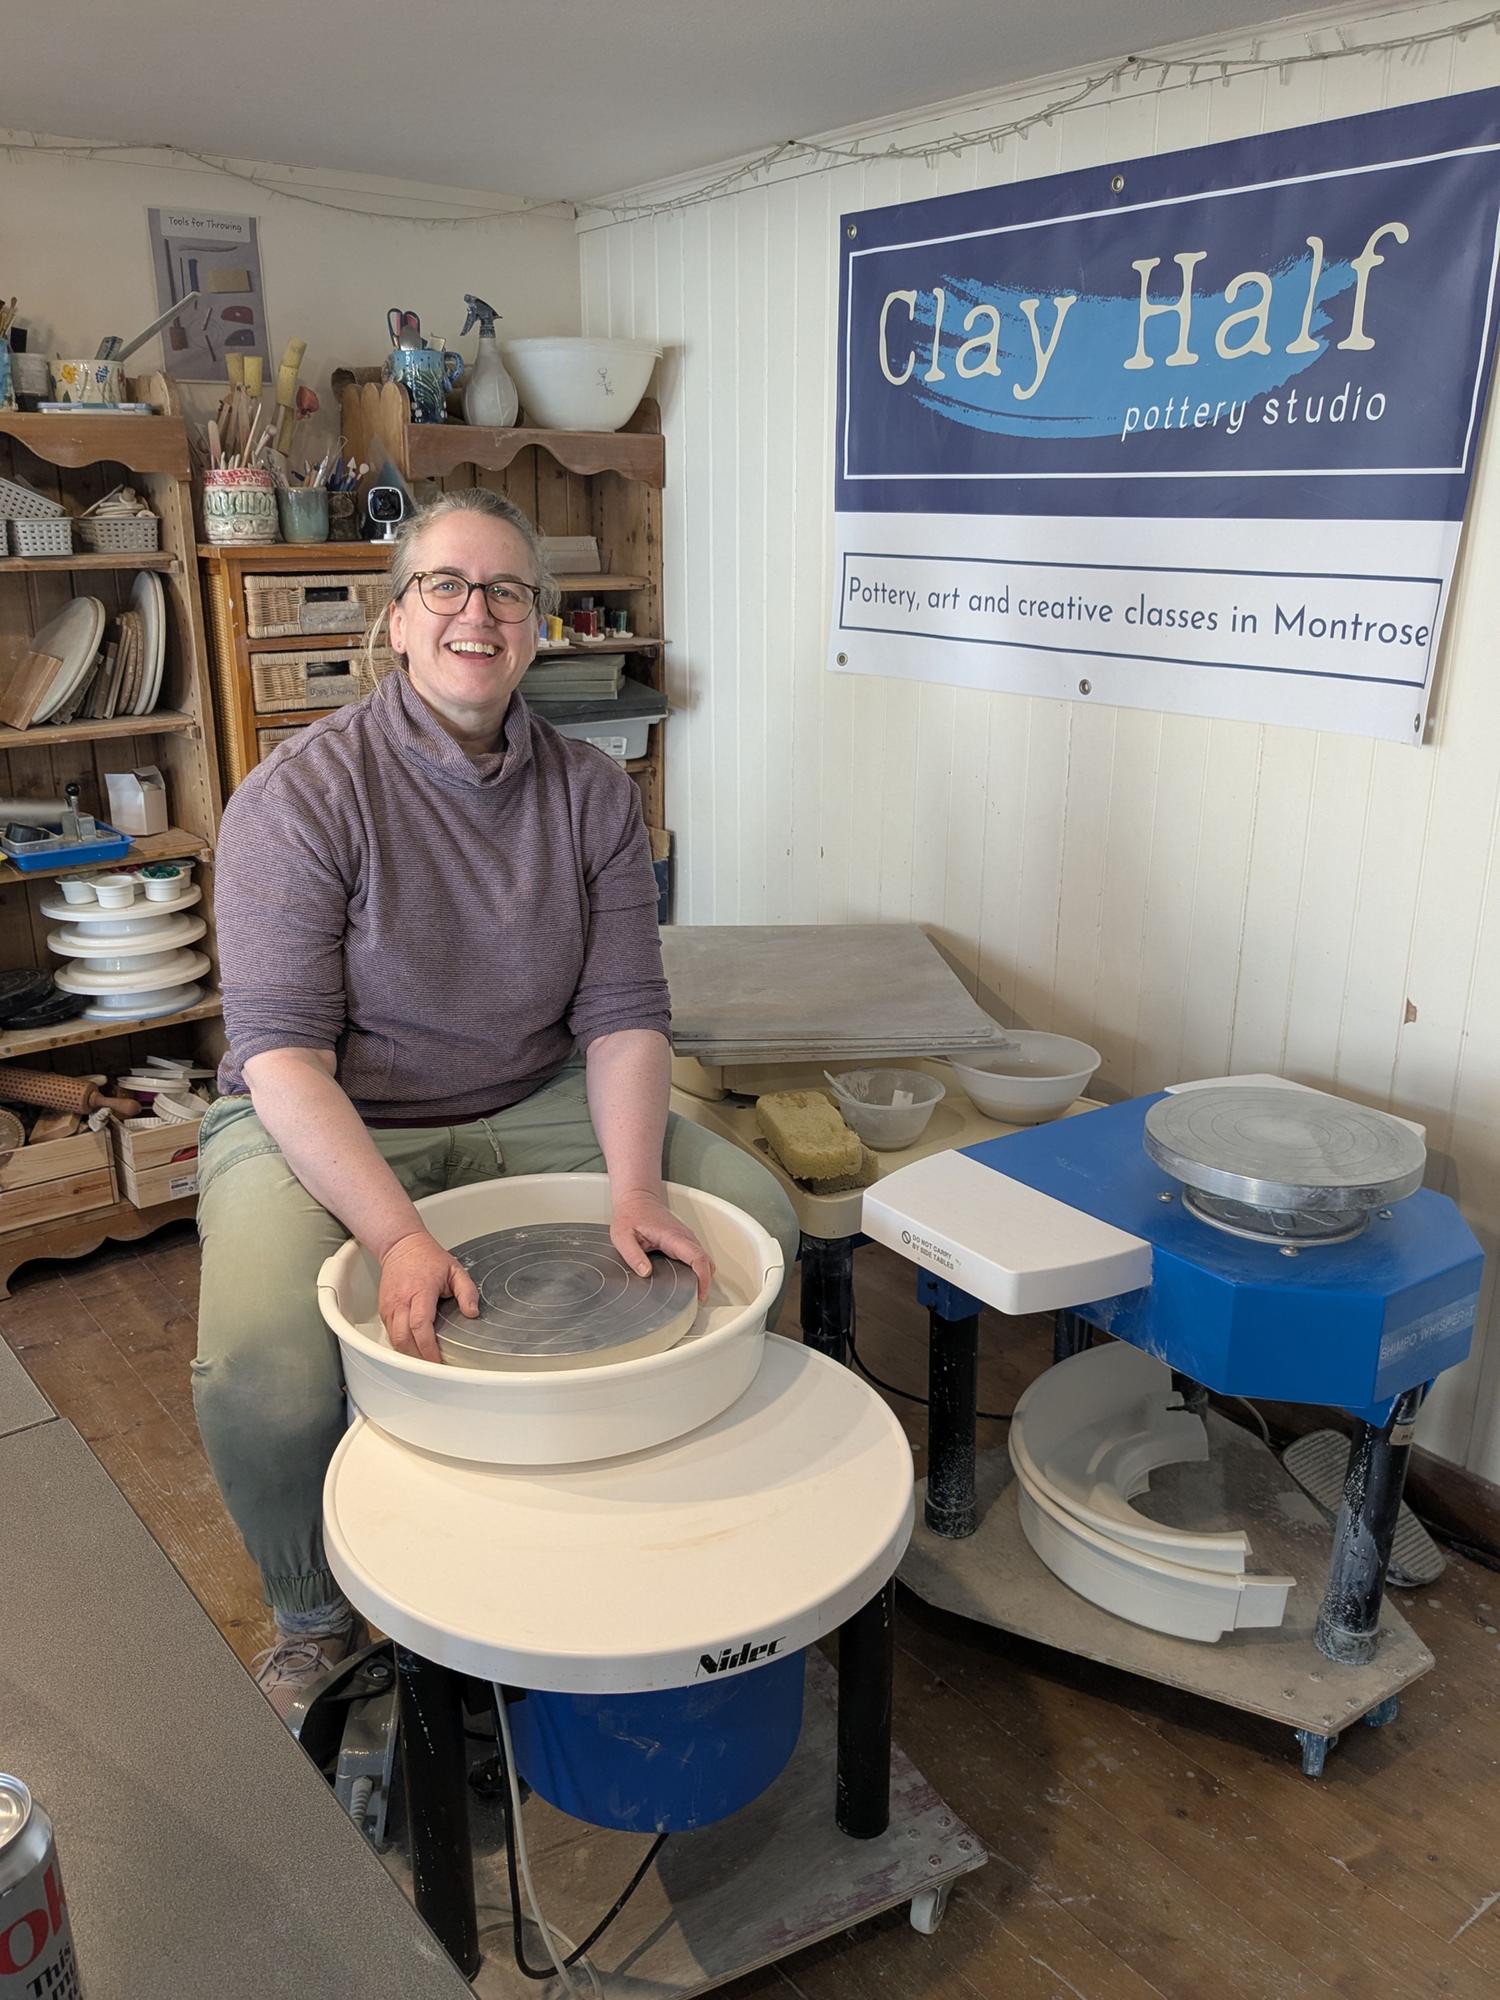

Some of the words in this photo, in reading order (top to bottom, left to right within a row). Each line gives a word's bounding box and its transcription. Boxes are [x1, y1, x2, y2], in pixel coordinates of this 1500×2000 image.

[168, 216, 190, 227] Tools
[191, 217, 204, 228] for
[206, 219, 243, 234] Throwing
[877, 288, 1077, 400] Clay
[1123, 221, 1410, 371] Half
[1121, 399, 1247, 442] pottery
[1262, 382, 1387, 425] studio
[848, 576, 920, 613] Pottery,
[927, 586, 960, 611] art
[968, 585, 1010, 616] and
[1018, 592, 1114, 625] creative
[1125, 593, 1218, 632] classes
[1232, 604, 1258, 635] in
[1273, 604, 1430, 649] Montrose
[921, 1239, 932, 1249] NOT
[695, 1635, 786, 1678] Nidec
